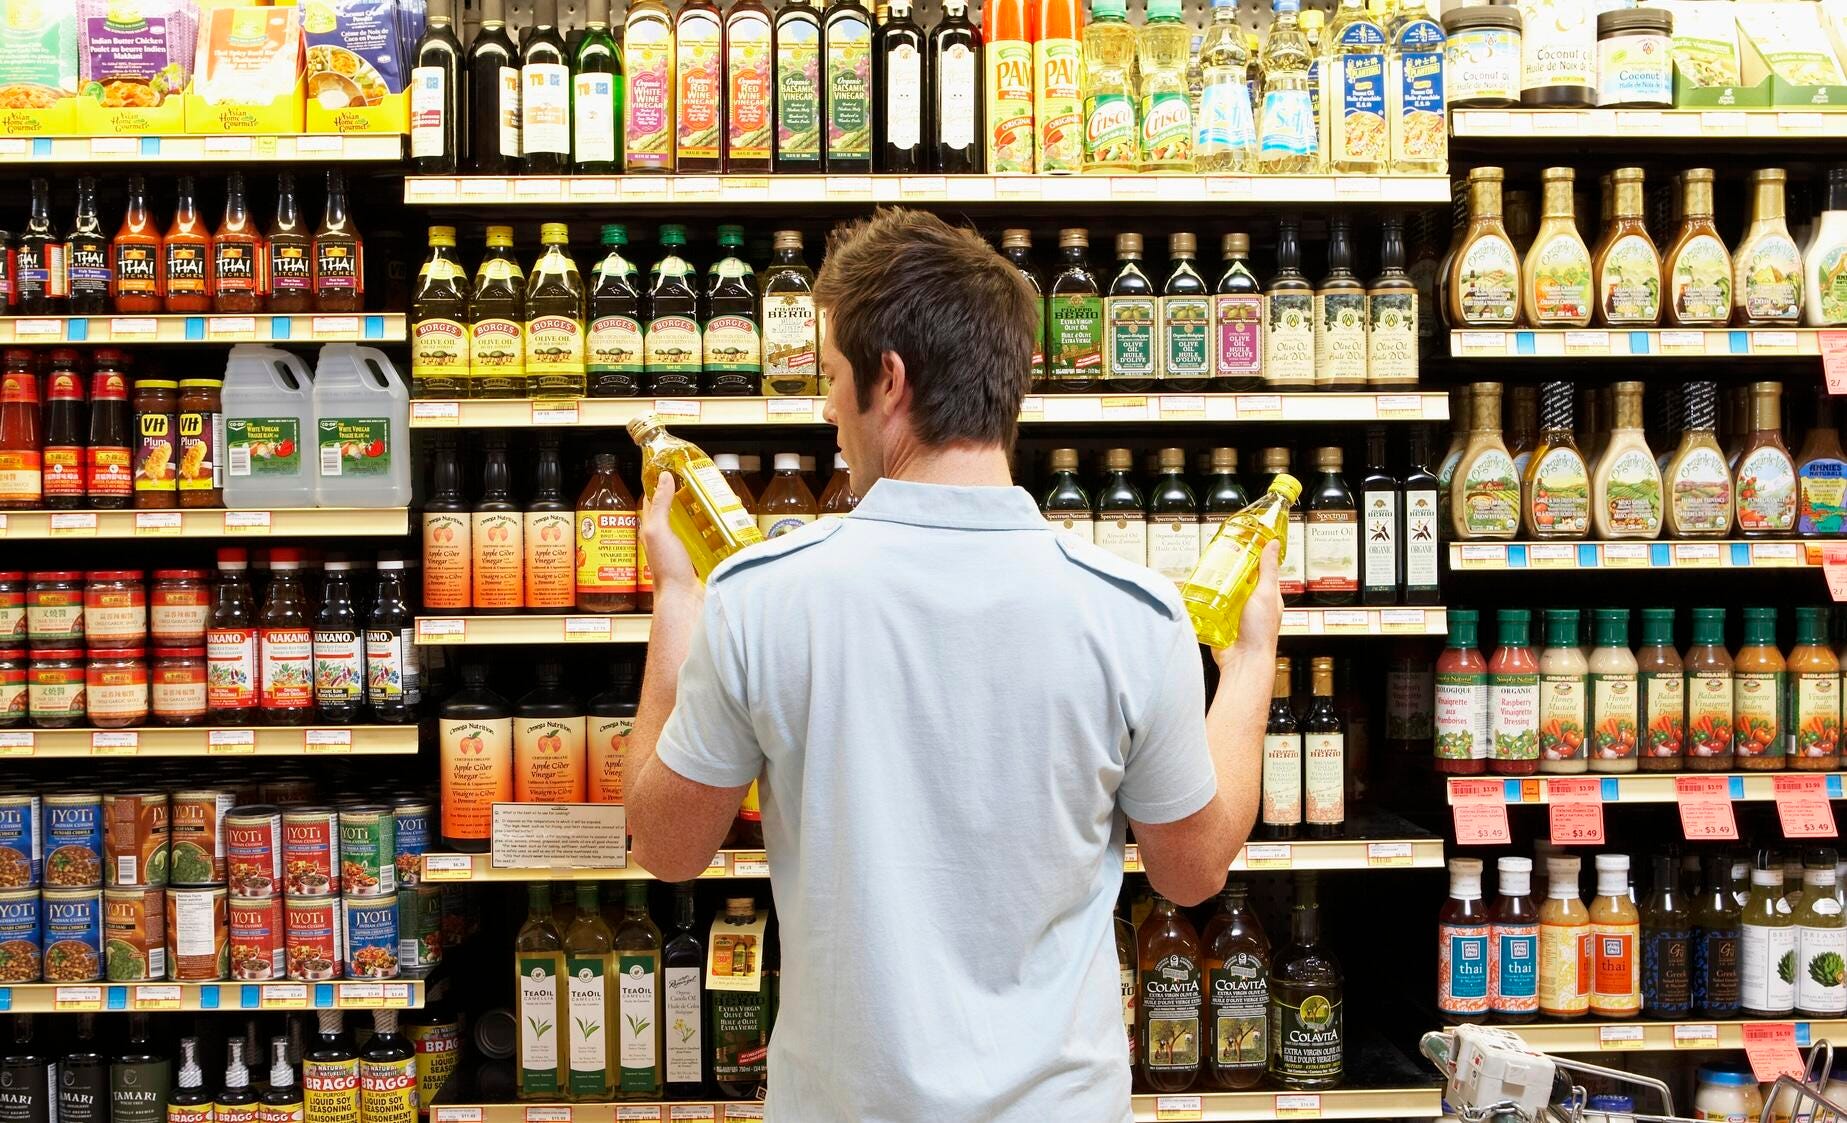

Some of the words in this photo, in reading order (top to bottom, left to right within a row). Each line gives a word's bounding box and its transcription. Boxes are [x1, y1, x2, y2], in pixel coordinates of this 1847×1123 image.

[113, 37, 134, 45] Butter
[136, 37, 164, 45] Chicken
[91, 46, 110, 54] Poulet
[121, 46, 143, 54] beurre
[1537, 49, 1580, 60] Coconut
[1619, 70, 1660, 81] Coconut
[634, 87, 662, 97] WHITE
[690, 83, 709, 93] RED
[781, 84, 814, 93] BALSAMIC
[832, 84, 865, 93] BALSAMIC
[636, 95, 661, 103] WINE
[687, 91, 712, 101] WINE
[783, 92, 814, 101] VINEGAR
[834, 92, 865, 101] VINEGAR
[1088, 107, 1131, 140] Crisco
[1145, 105, 1187, 138] Crisco
[75, 251, 104, 264] THAI
[118, 259, 155, 274] THAI
[167, 259, 203, 274] THAI
[216, 258, 251, 274] THAI
[273, 257, 309, 272] THAI
[319, 257, 355, 272] THAI
[768, 310, 812, 319] BERIO
[1055, 311, 1098, 319] BERIO
[419, 322, 457, 333] BORGES
[477, 322, 515, 333] BORGES
[535, 320, 573, 331] BORGES
[598, 320, 633, 330] BORGES
[656, 320, 692, 330] BORGES
[713, 320, 749, 330] BORGES
[143, 437, 167, 447] Plum
[181, 437, 201, 447] Plum
[1316, 511, 1349, 520] Spectrum
[1311, 527, 1339, 536] Peanut
[1341, 526, 1354, 537] Oil
[427, 549, 442, 559] Apple
[443, 549, 460, 558] Cider
[427, 558, 448, 566] Vinegar
[270, 632, 309, 642] NAKANO
[1501, 698, 1532, 708] Raspberry
[1501, 708, 1533, 717] Vinaigrette
[547, 720, 572, 733] Nutrition
[1504, 717, 1529, 726] Dressing
[449, 723, 467, 735] Omega
[468, 722, 495, 735] Nutrition
[454, 763, 472, 772] Apple
[531, 762, 550, 771] Apple
[454, 771, 478, 780] Vinegar
[531, 770, 556, 779] Vinegar
[1704, 825, 1730, 835] $3.49
[1804, 823, 1829, 832] $3.49
[1477, 829, 1503, 838] $3.49
[1572, 829, 1597, 838] $3.49
[1459, 963, 1483, 974] thai
[1508, 961, 1532, 973] thai
[1602, 959, 1626, 972] thai
[1147, 979, 1200, 993] COLAVITA
[1215, 977, 1268, 992] COLAVITA
[1289, 1028, 1338, 1043] COLAVITA
[1302, 1048, 1322, 1056] VIRGIN
[306, 1076, 356, 1091] BRAGG
[361, 1075, 408, 1091] BRAGG
[114, 1091, 157, 1102] TAMARI
[310, 1098, 335, 1106] LIQUID
[336, 1096, 351, 1104] SOY
[310, 1103, 352, 1113] SEASONING
[170, 1112, 203, 1122] BRAGG
